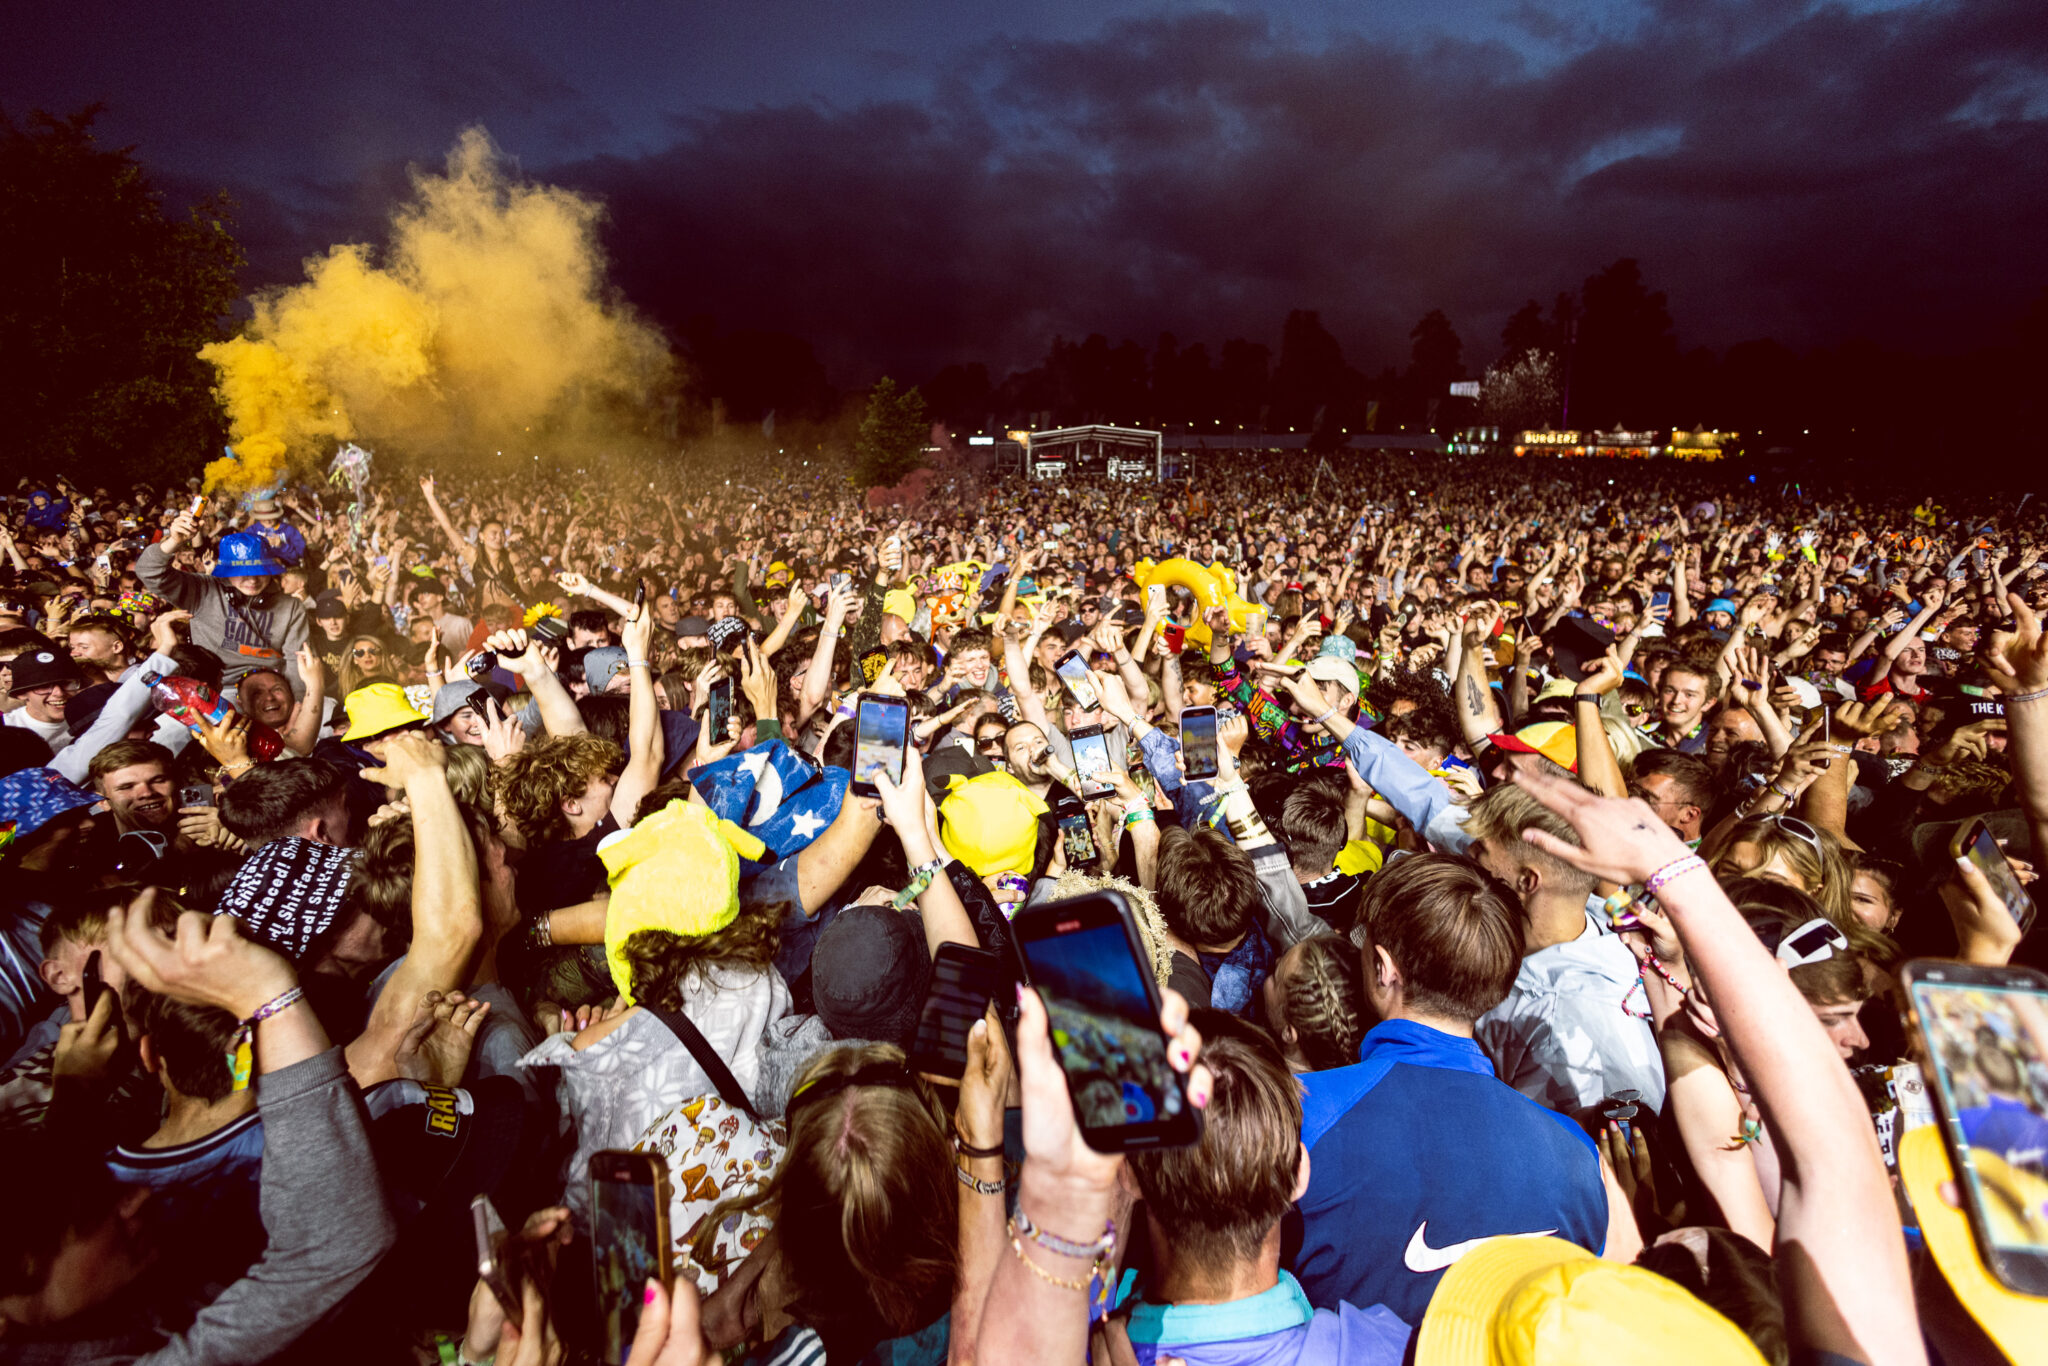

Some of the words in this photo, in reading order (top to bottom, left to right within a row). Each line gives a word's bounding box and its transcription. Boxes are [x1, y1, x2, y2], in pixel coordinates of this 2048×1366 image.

[1524, 433, 1578, 444] BURGERS
[1970, 702, 1995, 714] THE
[247, 862, 291, 933] itfaced!
[277, 846, 323, 921] Shitfaced!
